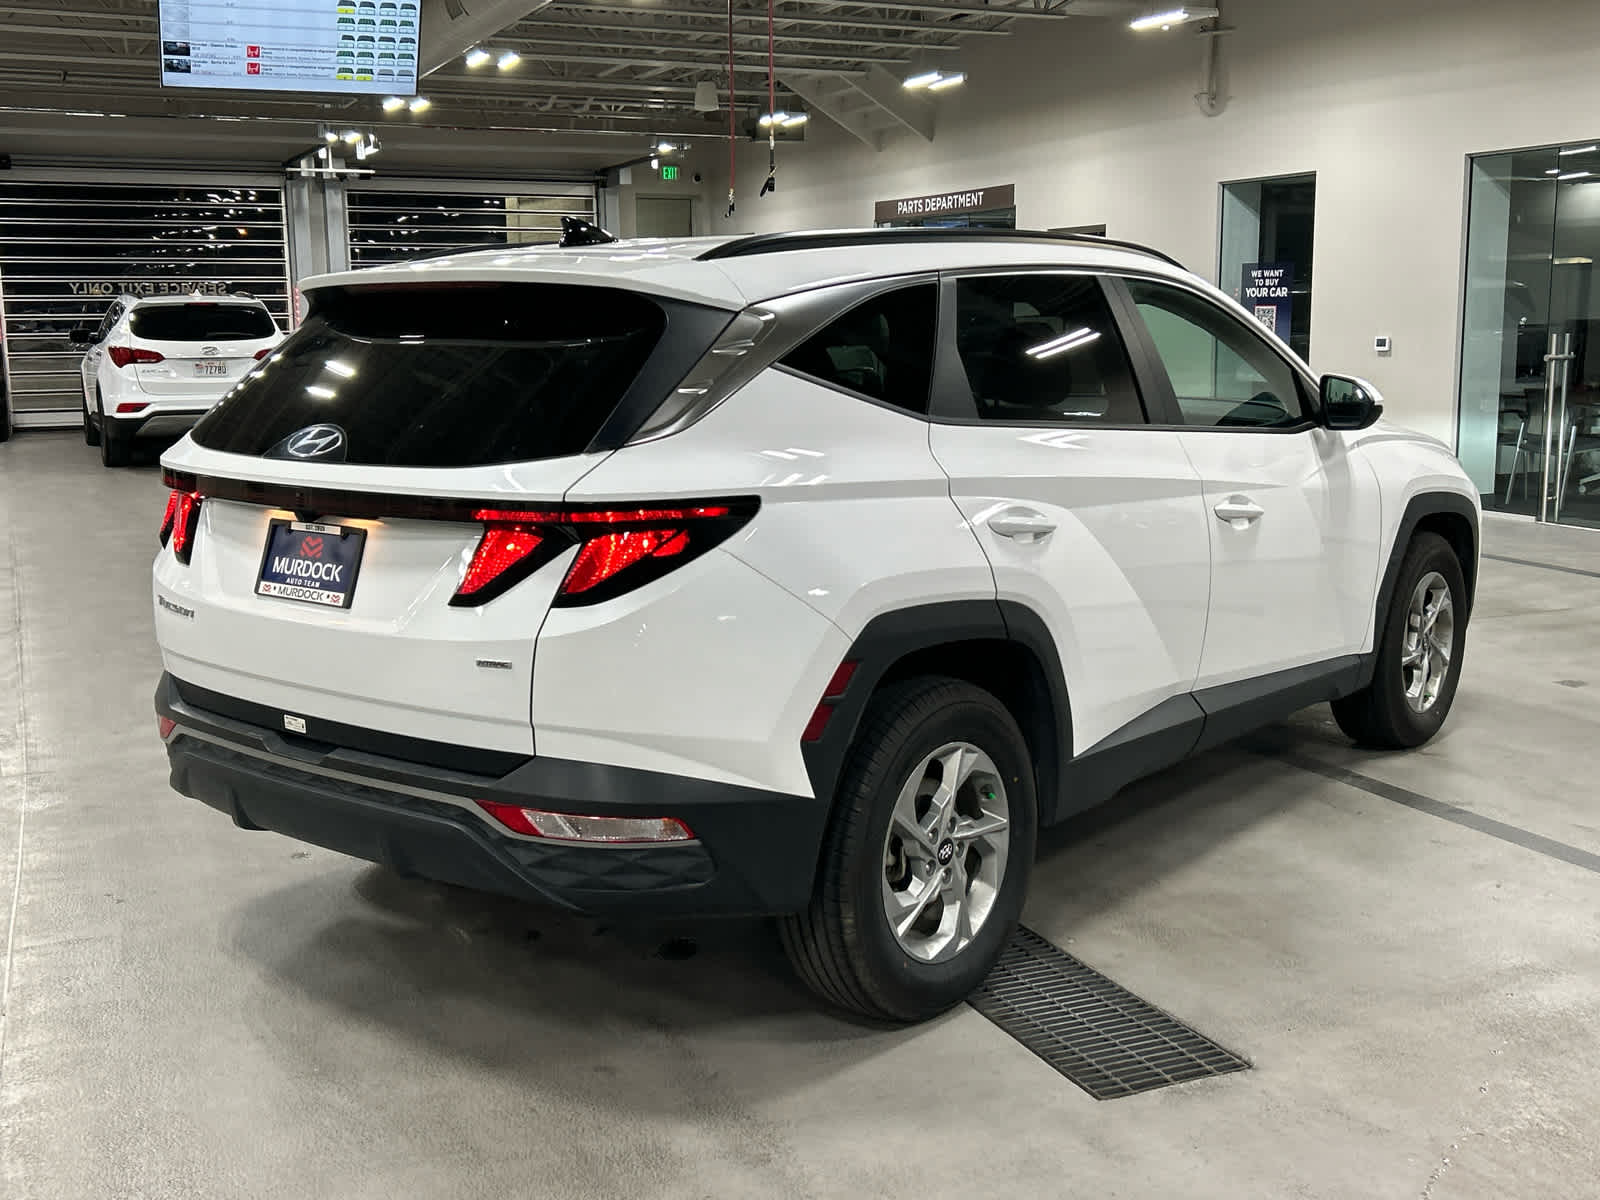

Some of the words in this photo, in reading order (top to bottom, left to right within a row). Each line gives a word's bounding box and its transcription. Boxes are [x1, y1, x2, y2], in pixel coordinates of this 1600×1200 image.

[663, 166, 678, 180] EXIT
[897, 199, 923, 215] PARTS
[924, 191, 984, 212] DEPARTMENT
[1251, 269, 1262, 278] WE
[1263, 269, 1284, 277] WANT
[1255, 279, 1264, 287] TO
[1265, 278, 1279, 286] BUY
[1245, 287, 1269, 298] YOUR
[1270, 287, 1288, 297] CAR
[272, 556, 343, 583] MURDOCK
[286, 578, 303, 586] AUTO
[304, 580, 320, 588] TEAM
[277, 585, 324, 602] MURDOCK
